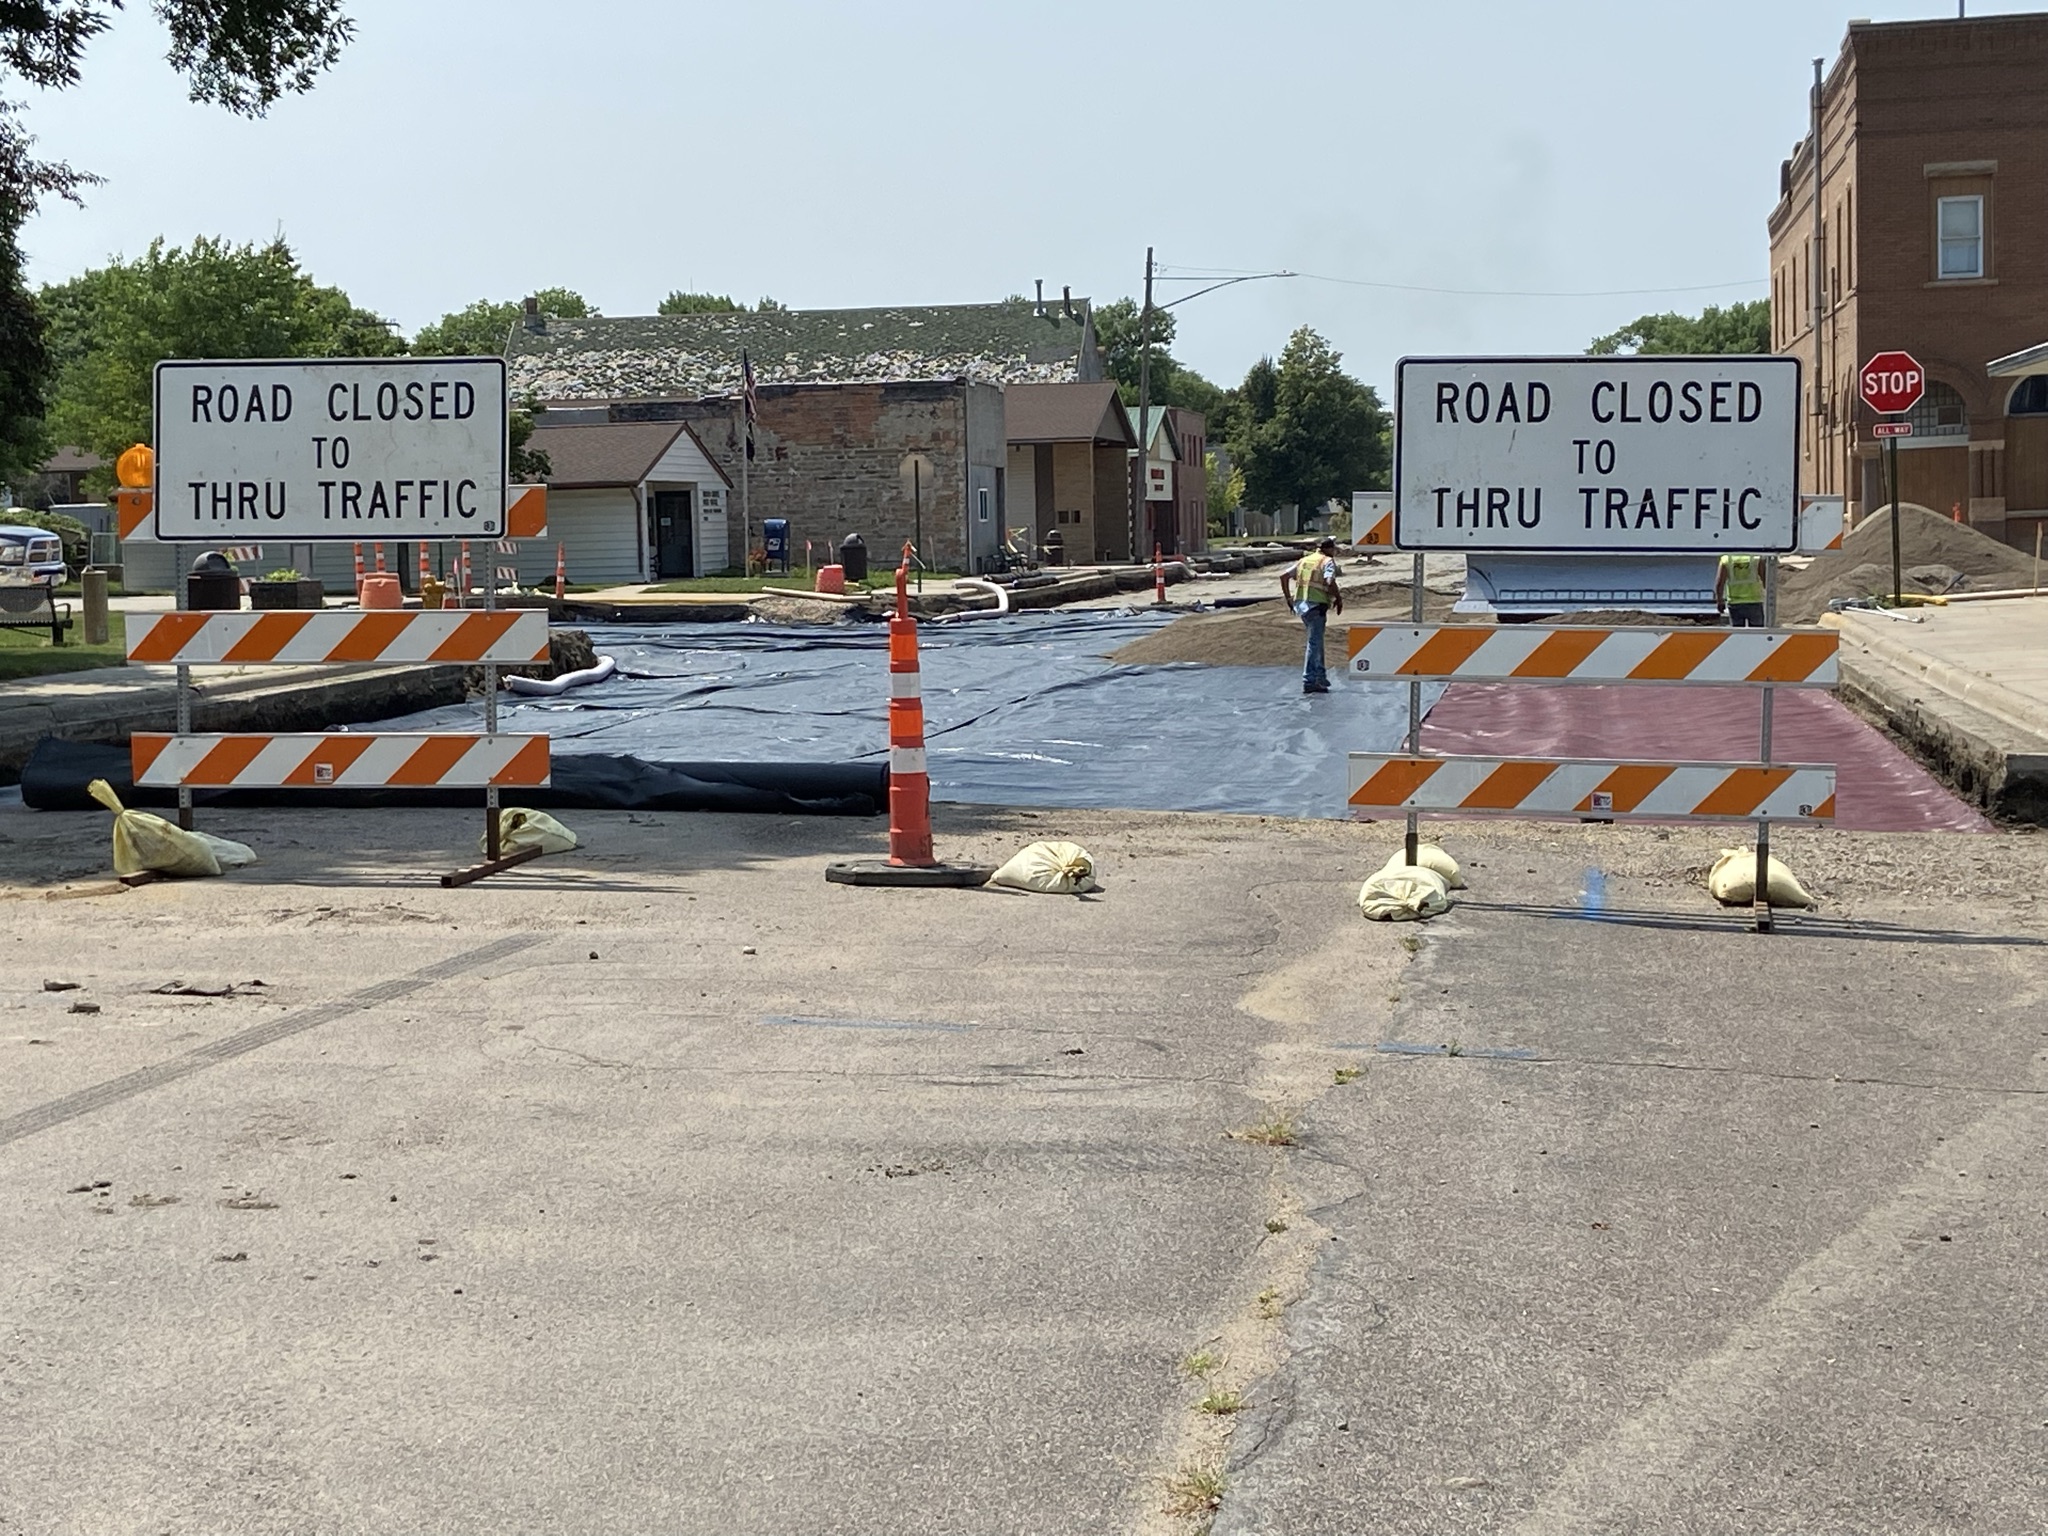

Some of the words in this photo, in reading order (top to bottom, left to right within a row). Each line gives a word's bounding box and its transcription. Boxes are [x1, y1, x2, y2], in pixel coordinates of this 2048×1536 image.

[192, 384, 292, 423] ROAD
[327, 381, 475, 422] CLOSED
[1436, 381, 1551, 424] ROAD
[1591, 380, 1762, 424] CLOSED
[1865, 371, 1919, 395] STOP
[311, 436, 350, 469] TO
[1572, 439, 1616, 475] TO
[187, 481, 286, 520] THRU
[317, 479, 477, 519] TRAFFIC
[1430, 487, 1541, 529] THRU
[1578, 487, 1762, 530] TRAFFIC
